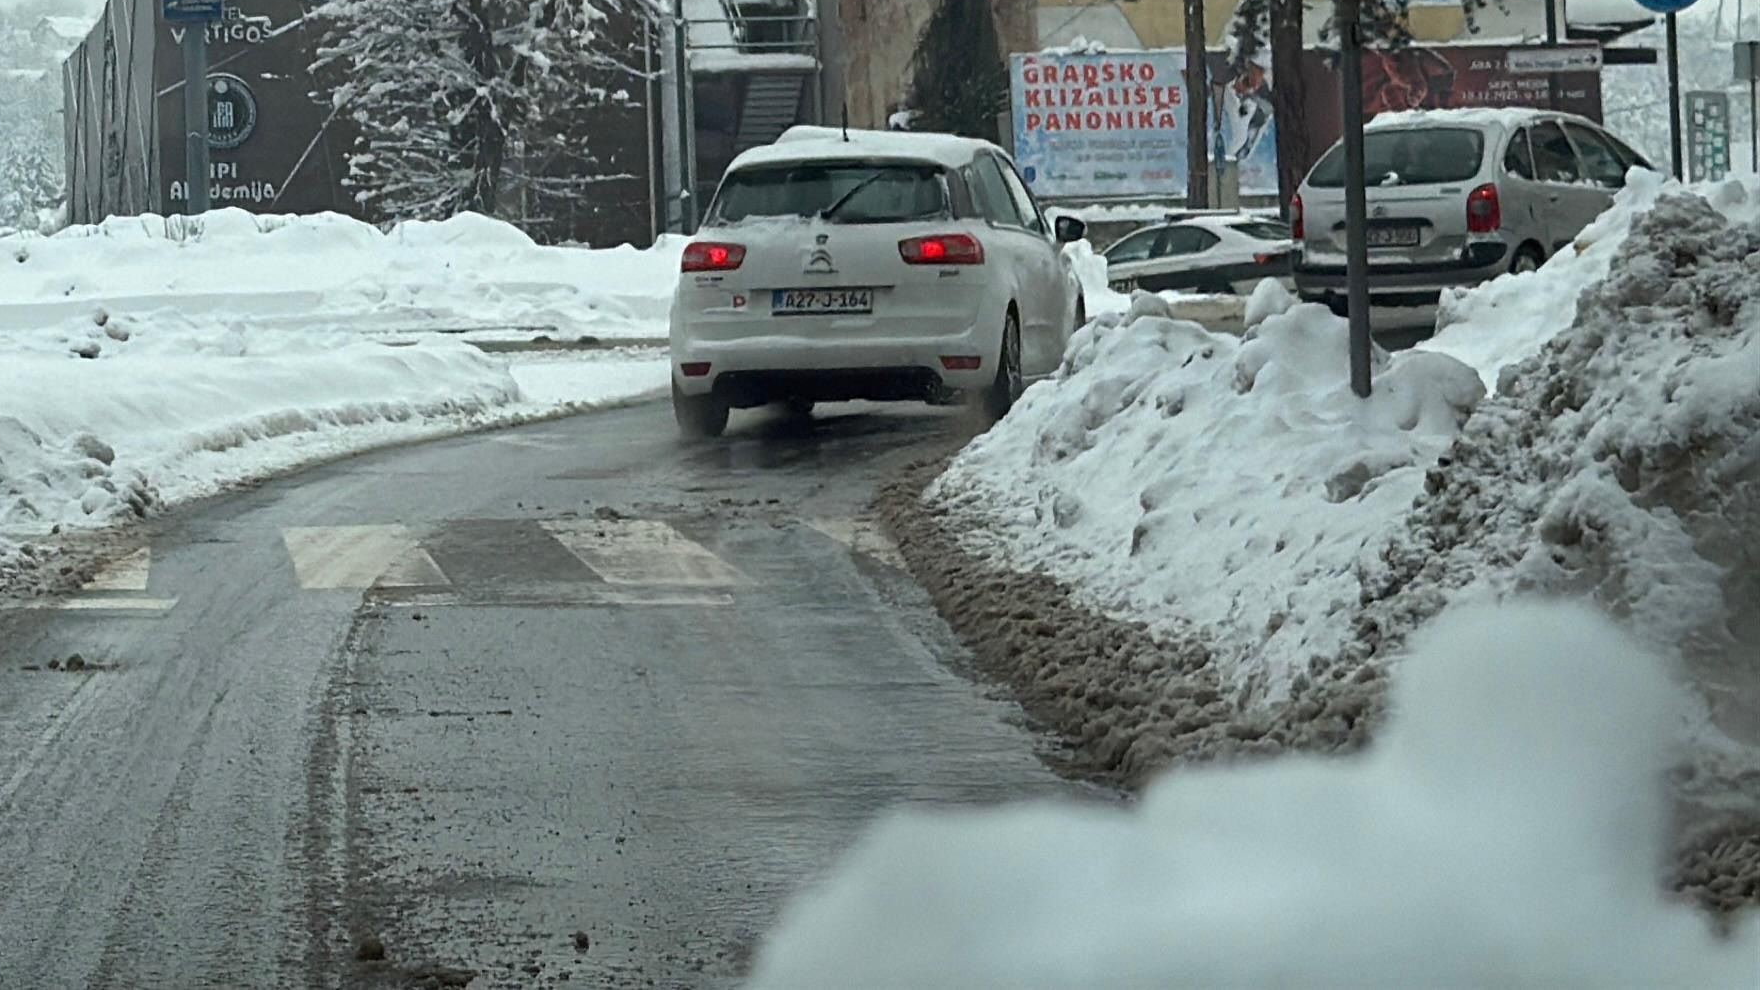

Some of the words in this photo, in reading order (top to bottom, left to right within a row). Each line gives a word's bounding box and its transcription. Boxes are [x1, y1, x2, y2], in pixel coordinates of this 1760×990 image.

[1022, 60, 1155, 86] GRADSKO
[1024, 84, 1182, 109] KLIZALIŠTE
[1026, 111, 1176, 131] PANONIKA
[170, 181, 275, 202] Ademija
[786, 289, 869, 309] A27-J-164
